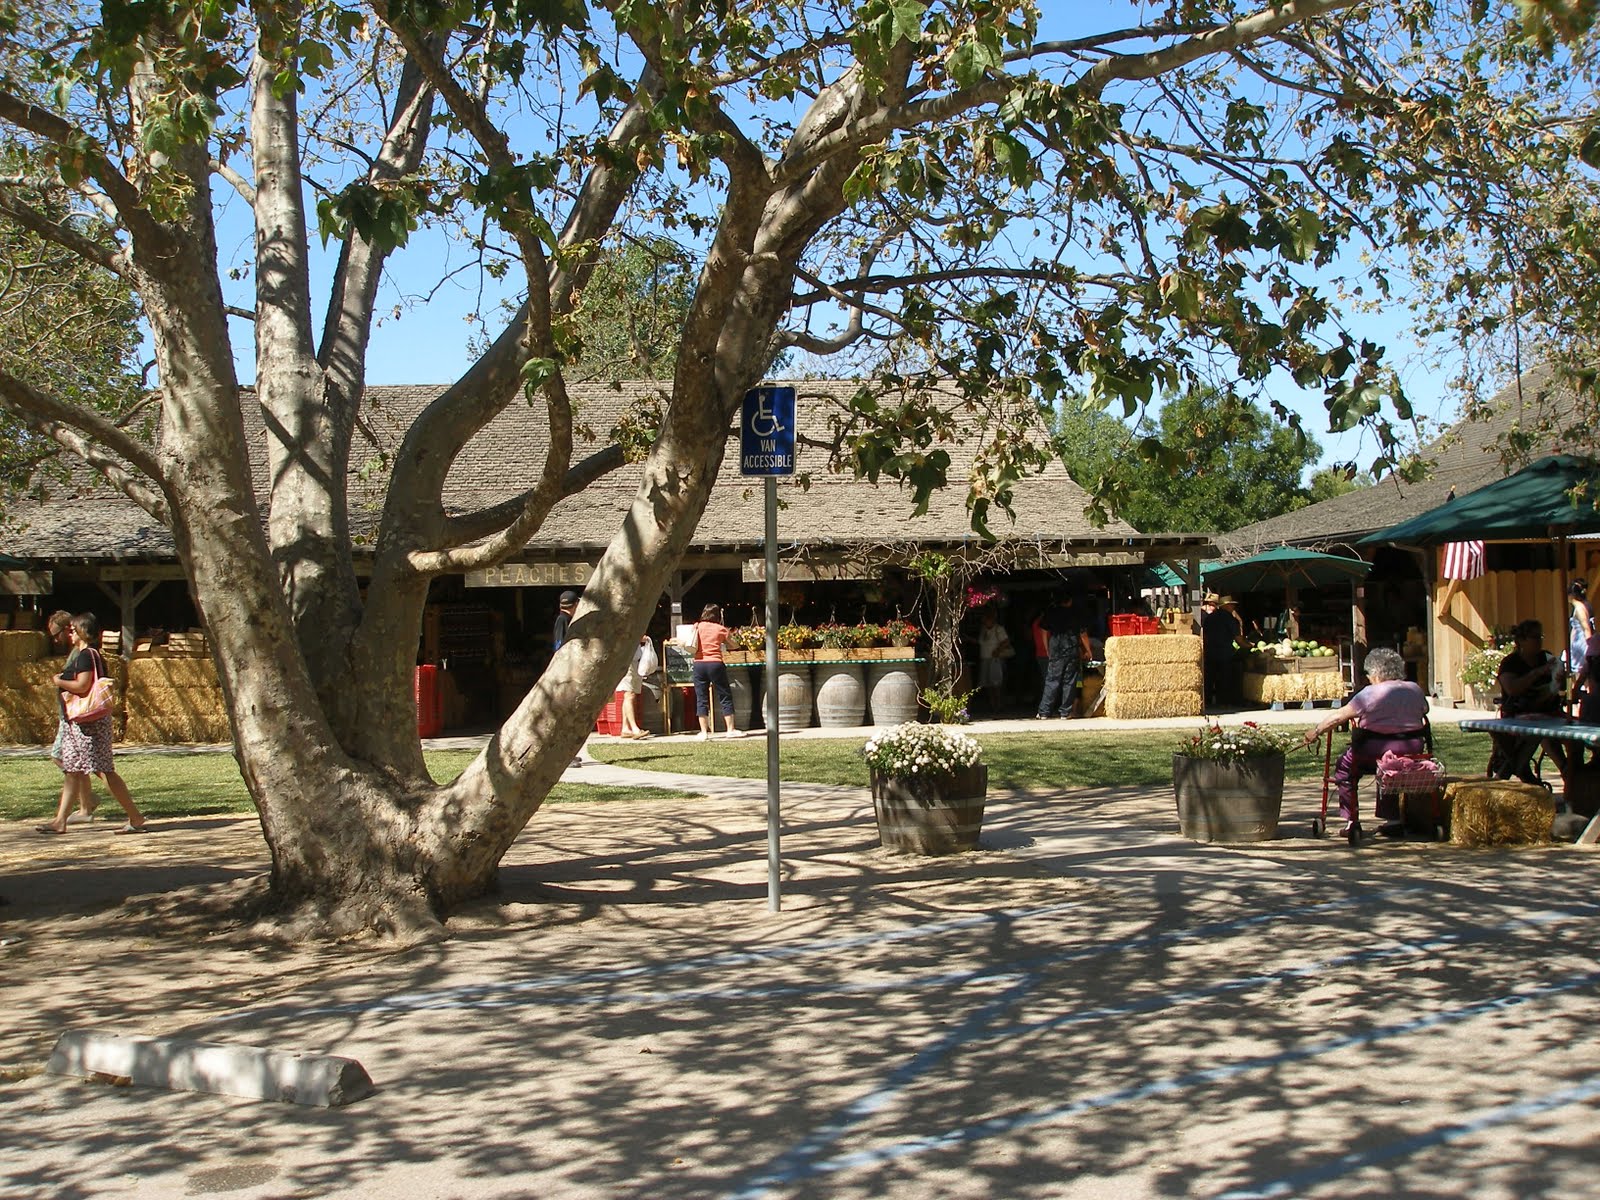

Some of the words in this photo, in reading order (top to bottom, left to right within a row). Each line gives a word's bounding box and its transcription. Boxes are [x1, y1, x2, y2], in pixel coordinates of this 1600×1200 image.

[760, 439, 776, 452] VAN
[743, 454, 792, 468] ACCESSIBLE
[485, 566, 585, 584] PEACHES
